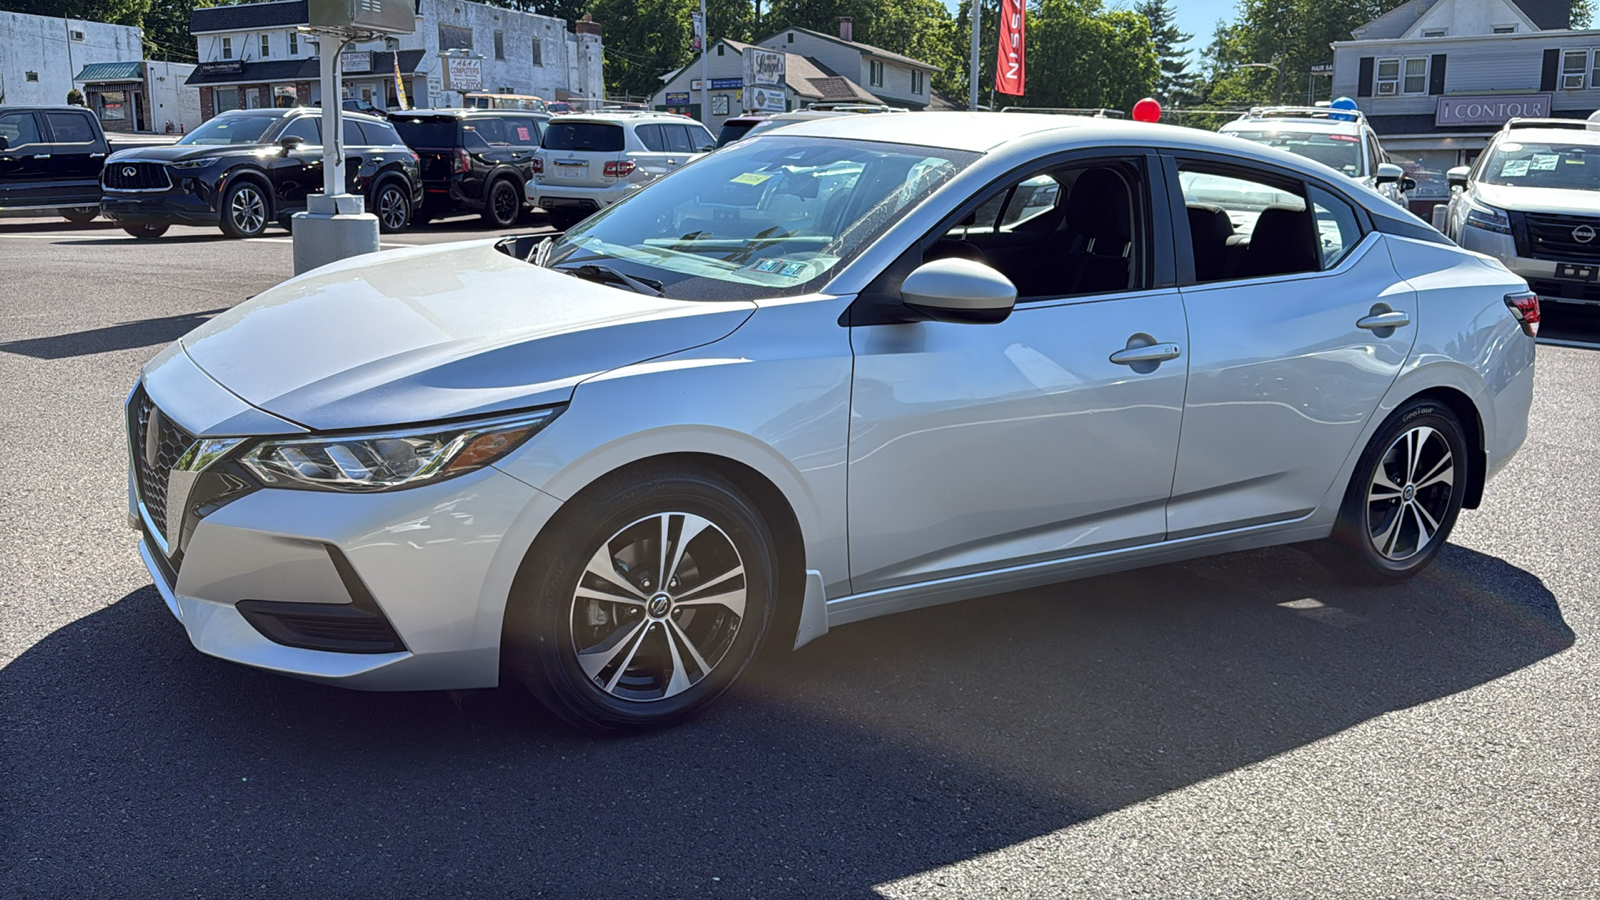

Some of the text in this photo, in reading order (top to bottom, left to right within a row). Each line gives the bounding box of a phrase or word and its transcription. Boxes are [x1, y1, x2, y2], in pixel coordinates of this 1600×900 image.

[450, 82, 482, 90] 942-9700
[1455, 102, 1542, 118] CONTOUR
[1402, 408, 1434, 422] GeoTour
